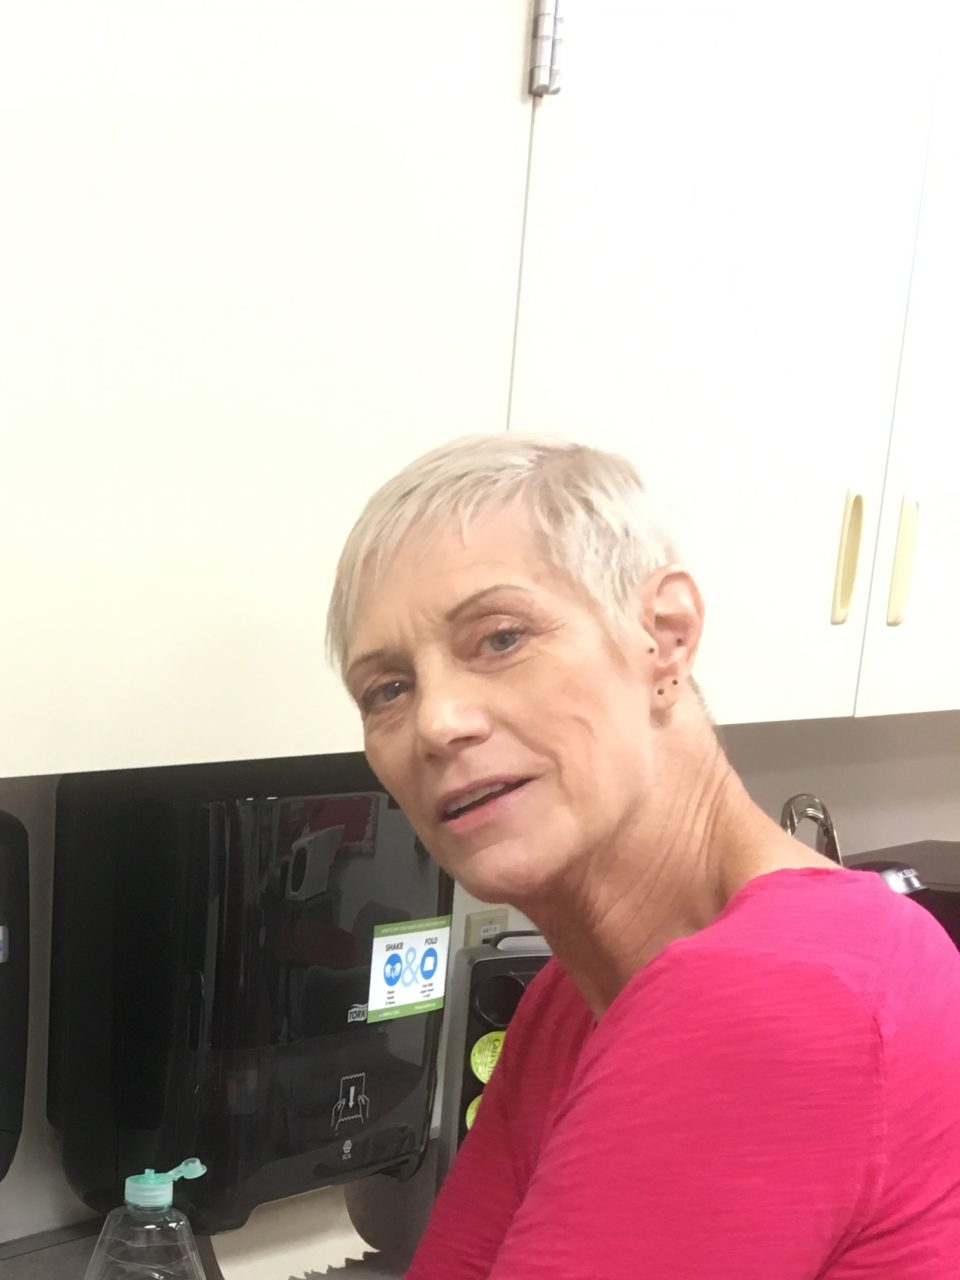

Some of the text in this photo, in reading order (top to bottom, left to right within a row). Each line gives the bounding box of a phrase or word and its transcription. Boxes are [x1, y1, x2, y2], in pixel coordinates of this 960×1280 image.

[385, 942, 404, 952] SHAKE
[424, 936, 438, 945] FOLD
[348, 1010, 366, 1021] TORK
